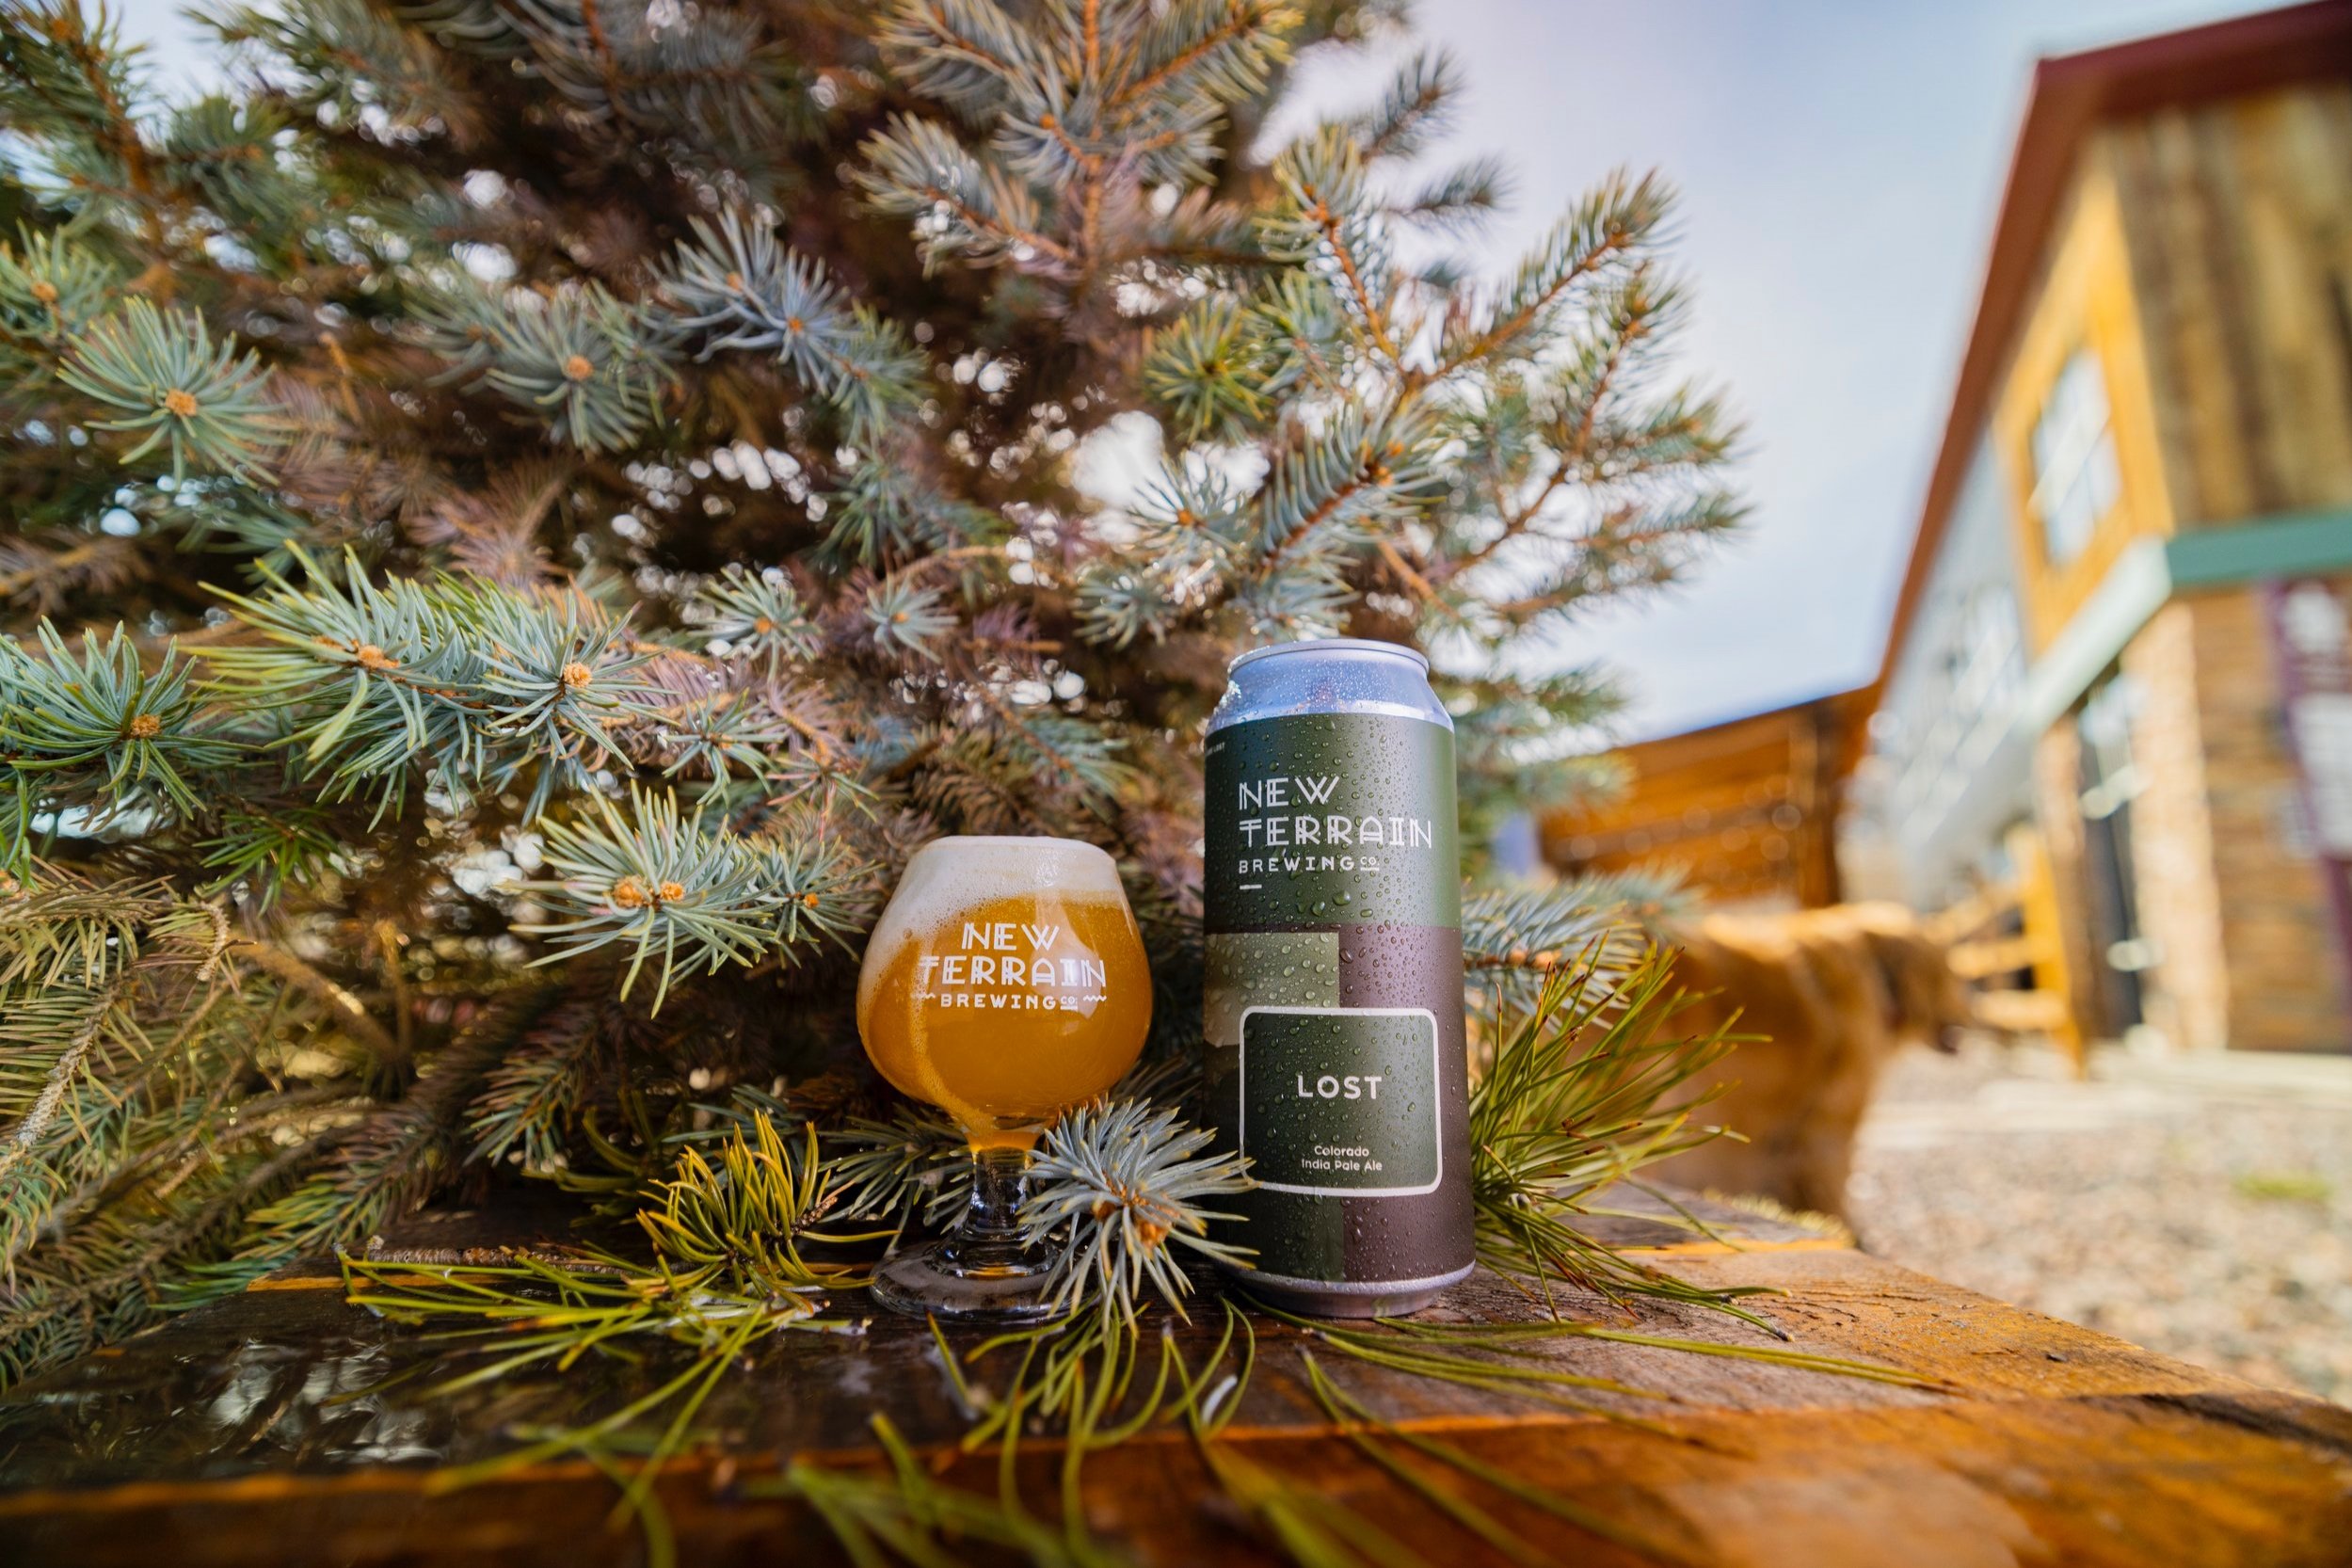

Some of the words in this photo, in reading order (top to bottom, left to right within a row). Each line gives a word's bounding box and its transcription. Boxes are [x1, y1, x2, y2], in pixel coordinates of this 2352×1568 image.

[1239, 776, 1340, 809] NEW
[1239, 815, 1432, 849] TERRAIN
[1239, 856, 1355, 874] BREWING
[961, 922, 1060, 951] NEW
[919, 955, 1107, 987] TERRAIN
[940, 993, 1056, 1010] BREWING
[1297, 1074, 1383, 1099] LOST
[1314, 1145, 1369, 1158] Colorado
[1302, 1158, 1330, 1171] India
[1335, 1159, 1361, 1172] Pale
[1364, 1160, 1383, 1172] Ale
